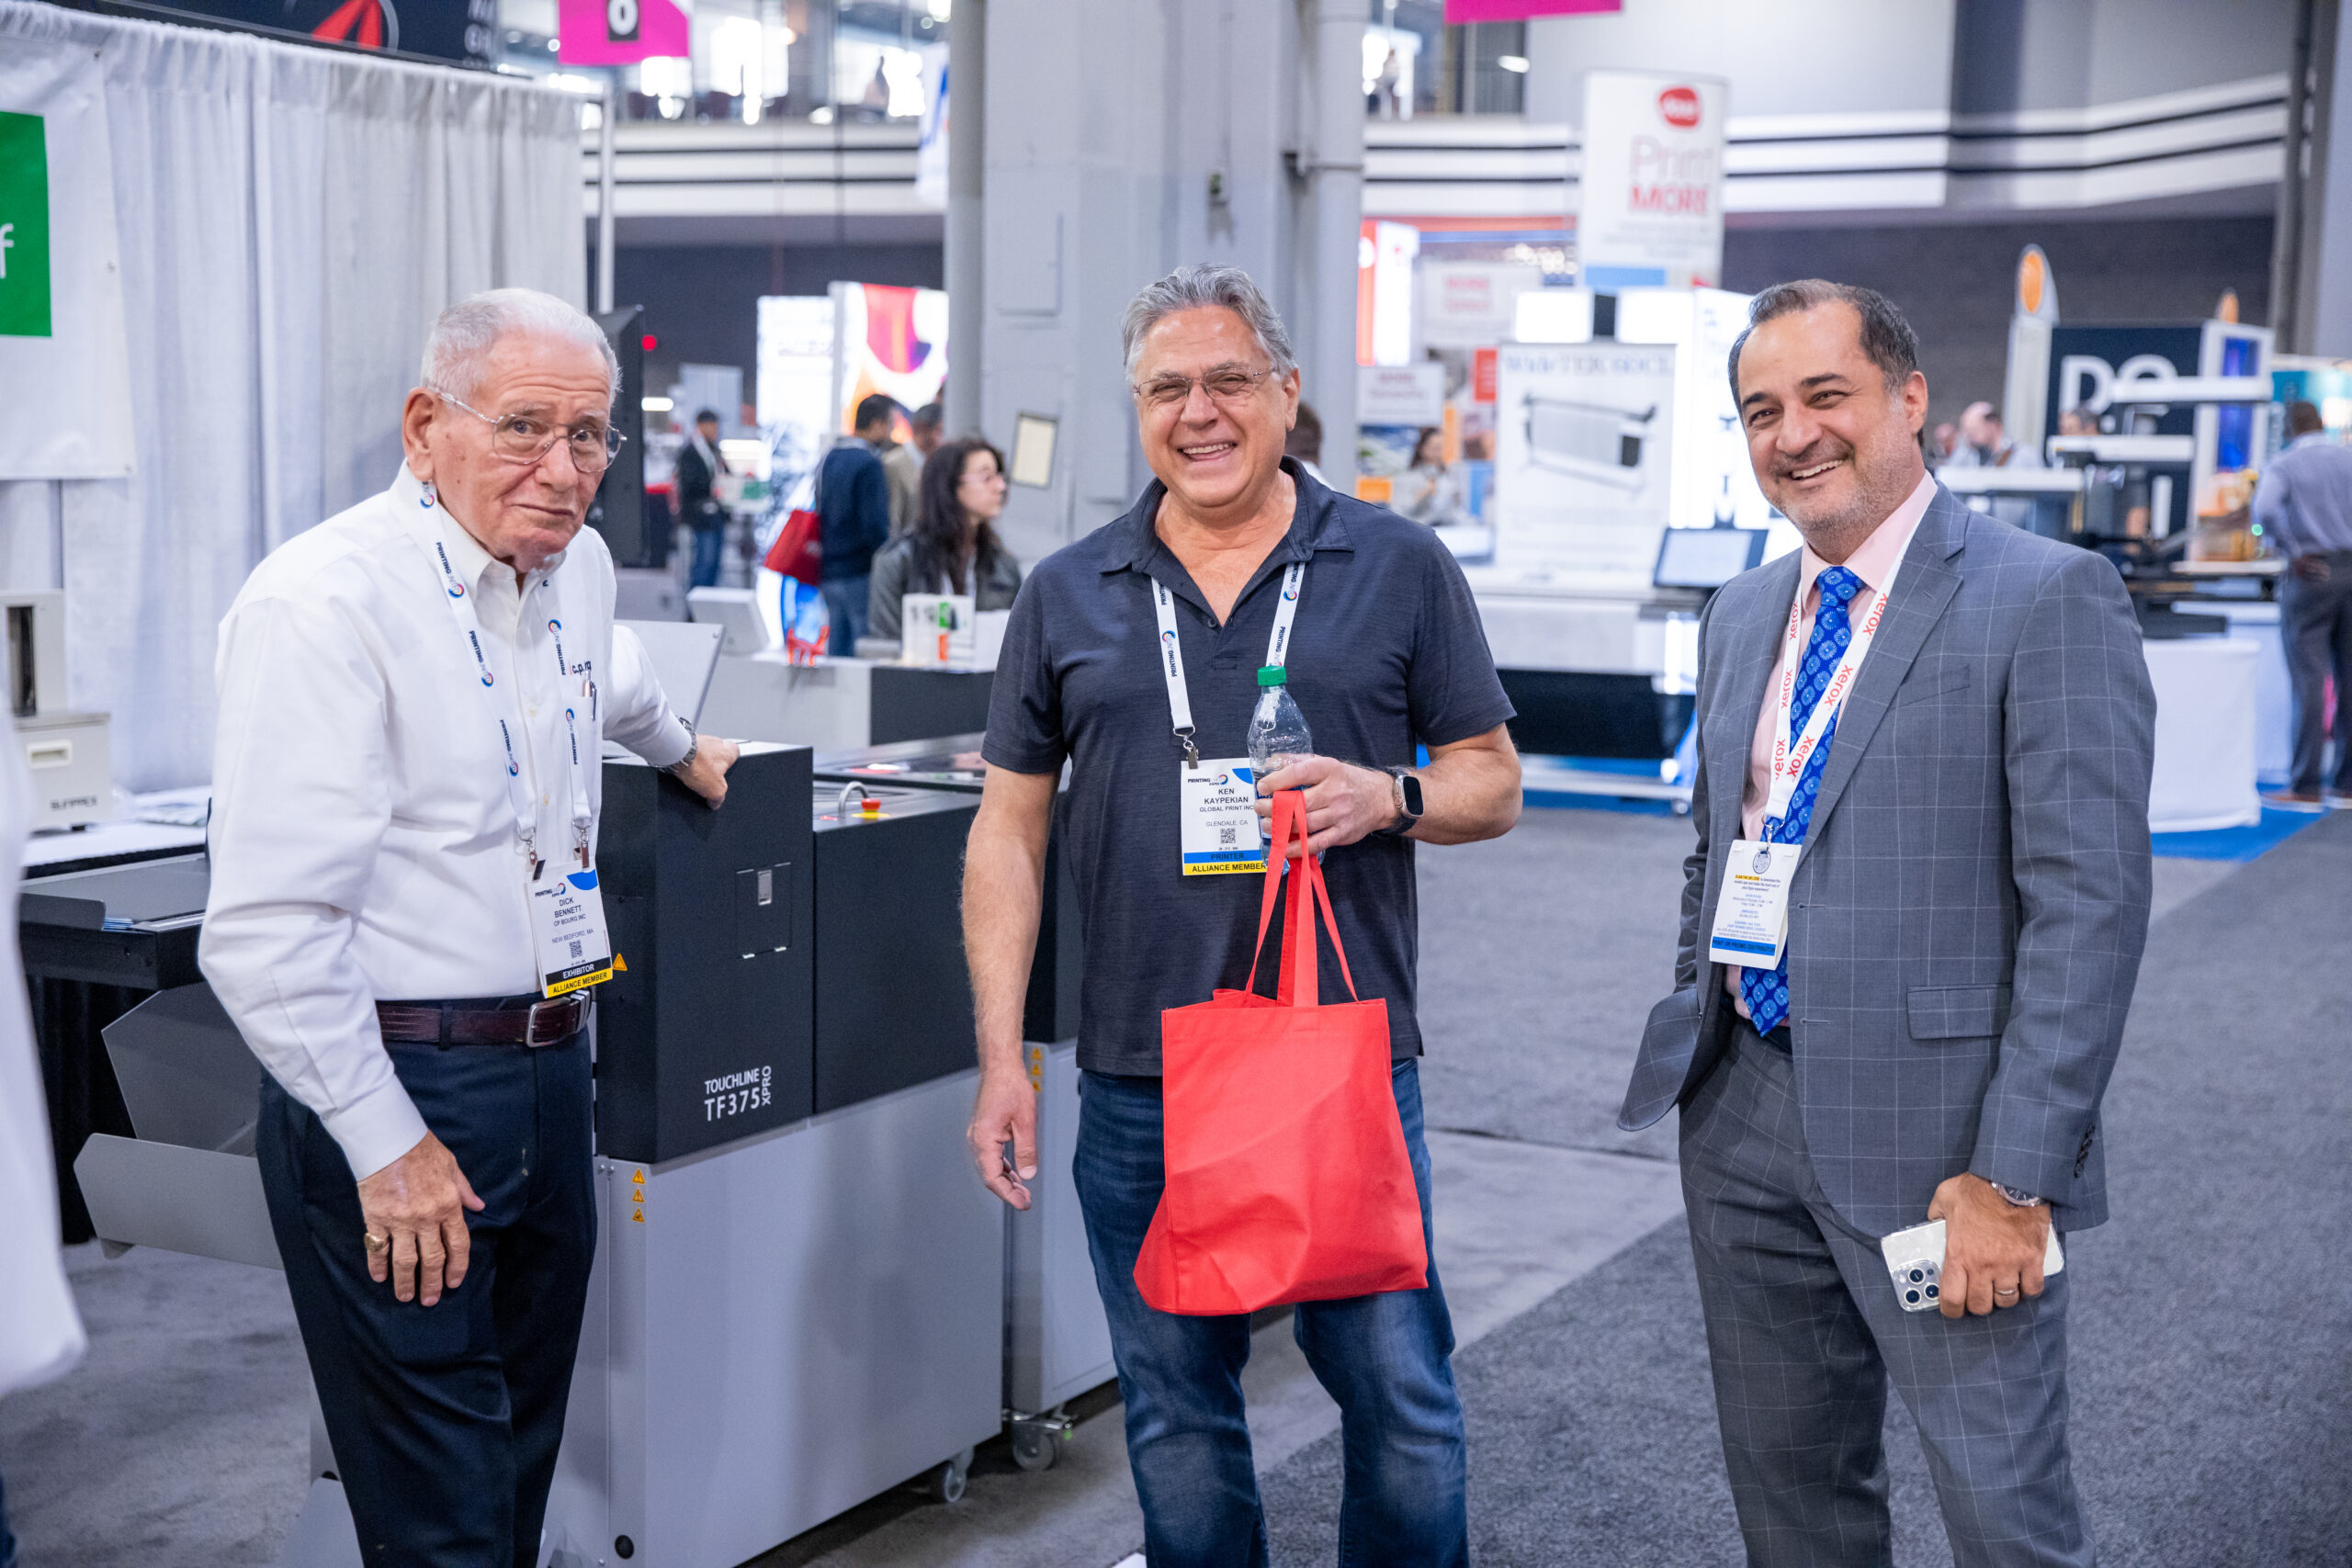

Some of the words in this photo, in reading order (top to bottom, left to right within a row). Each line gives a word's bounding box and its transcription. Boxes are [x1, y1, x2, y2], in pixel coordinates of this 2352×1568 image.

[1789, 602, 1799, 640] xerox
[1781, 669, 1793, 709] xerox
[1824, 664, 1854, 706] xerox
[1786, 736, 1815, 778] xerox
[1204, 796, 1249, 805] KAYPEKIAN
[1211, 852, 1245, 861] PRINTER
[1192, 863, 1231, 873] ALLIANCE
[1232, 862, 1268, 872] MEMBER
[559, 897, 574, 907] DICK
[554, 905, 582, 919] BENNETT
[561, 917, 578, 925] BOURG
[578, 913, 586, 921] INC
[551, 936, 564, 944] NEW
[562, 964, 595, 979] EXHIBITOR
[552, 979, 582, 994] ALLIANCE
[582, 972, 608, 985] MEMBER
[704, 1067, 760, 1095] TOUCHLINE
[761, 1065, 772, 1106] XPRO
[704, 1087, 760, 1122] TF375
